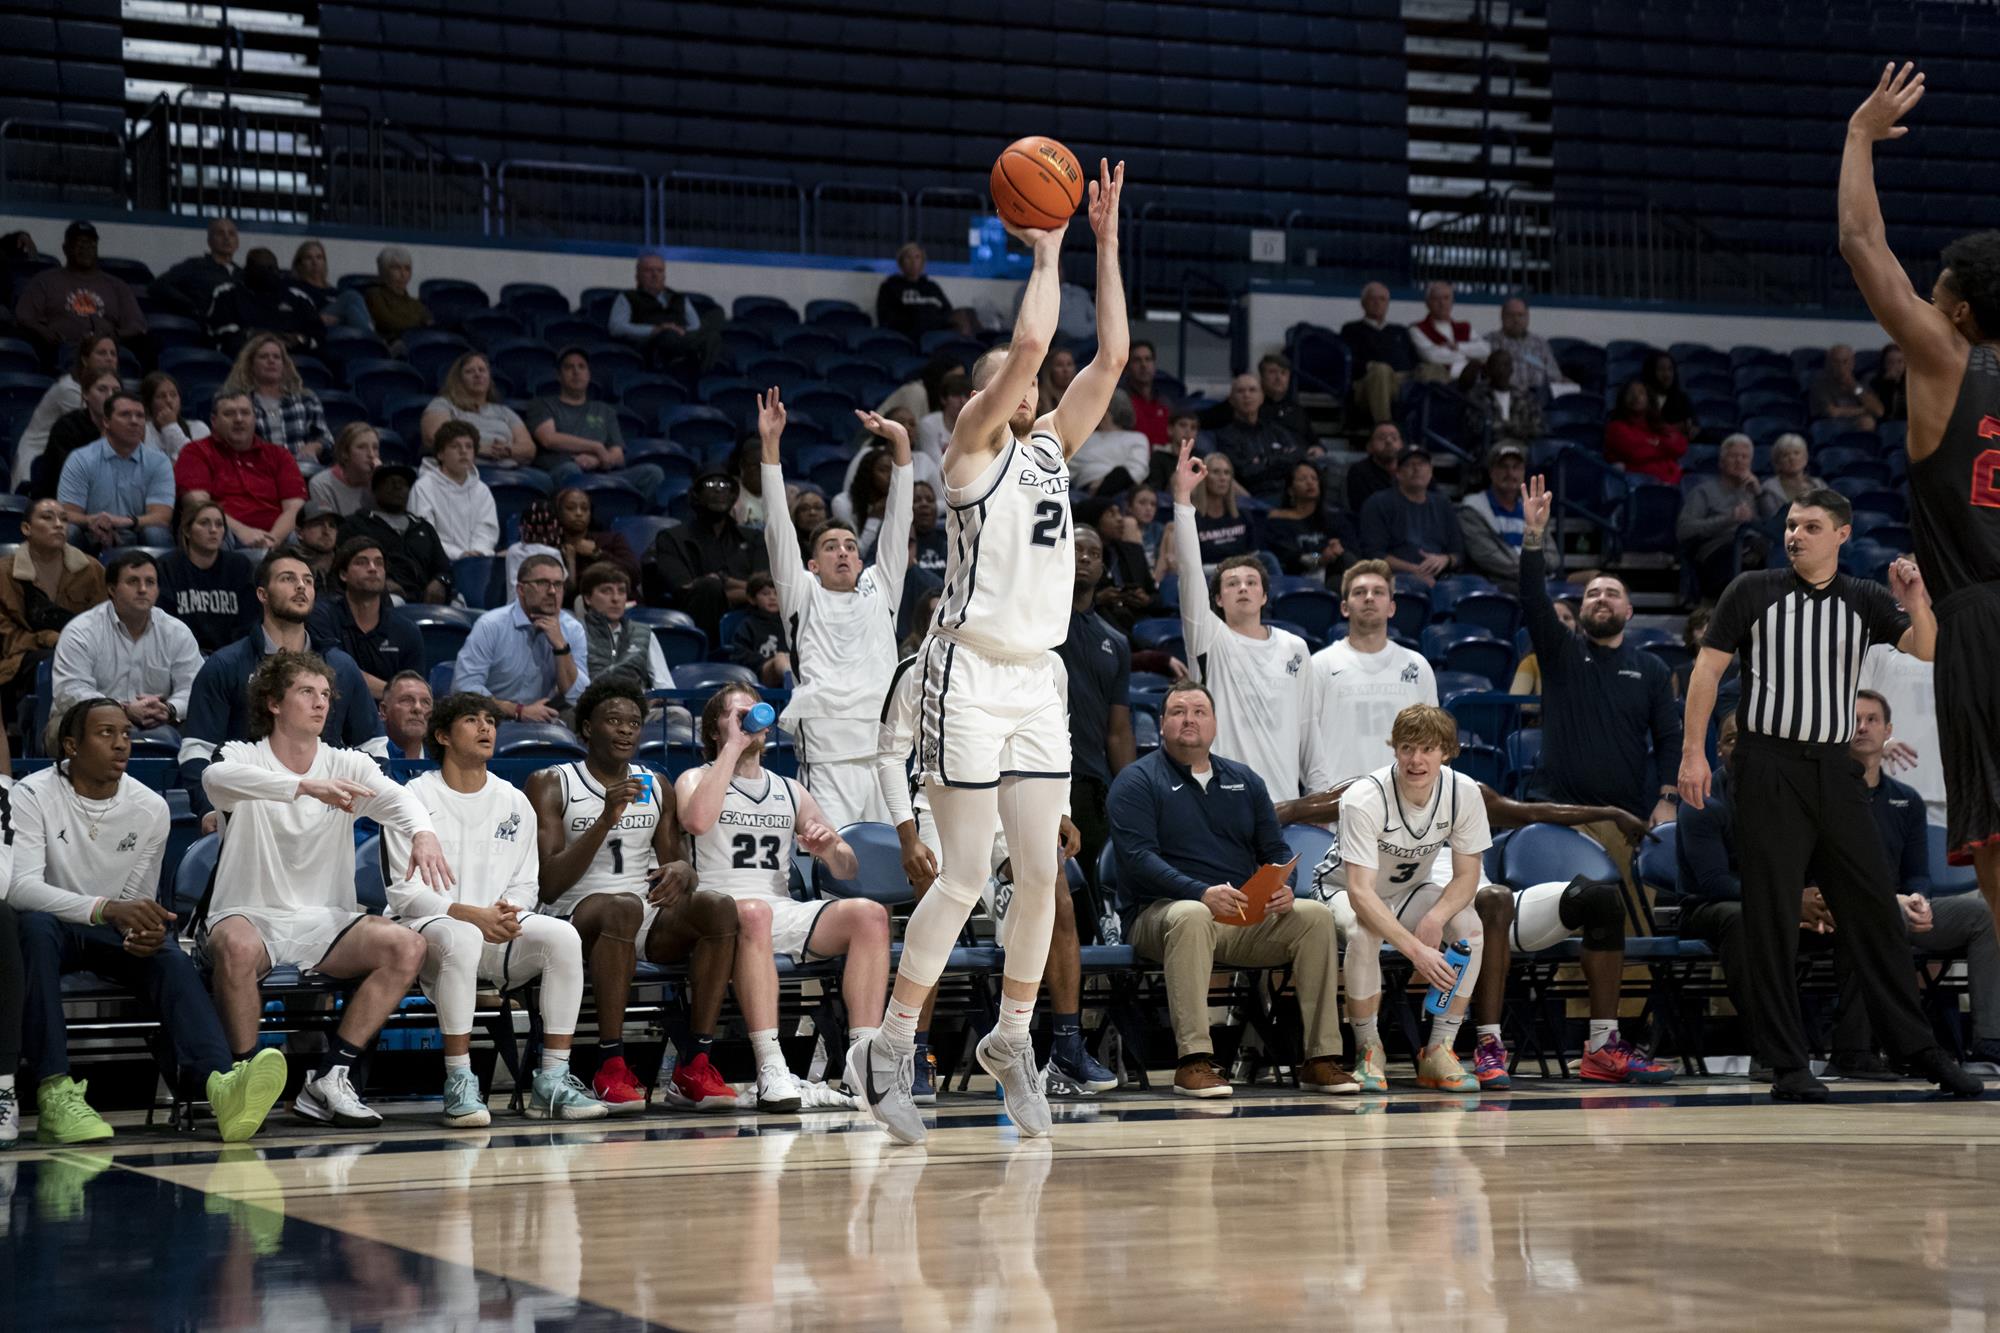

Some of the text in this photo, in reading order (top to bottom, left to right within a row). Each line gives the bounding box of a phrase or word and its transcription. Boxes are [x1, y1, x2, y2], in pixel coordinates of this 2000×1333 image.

[1038, 144, 1078, 184] ELITE
[719, 810, 791, 829] SAMFORD
[607, 838, 624, 875] 1
[731, 833, 781, 871] 23
[1389, 862, 1421, 884] 3
